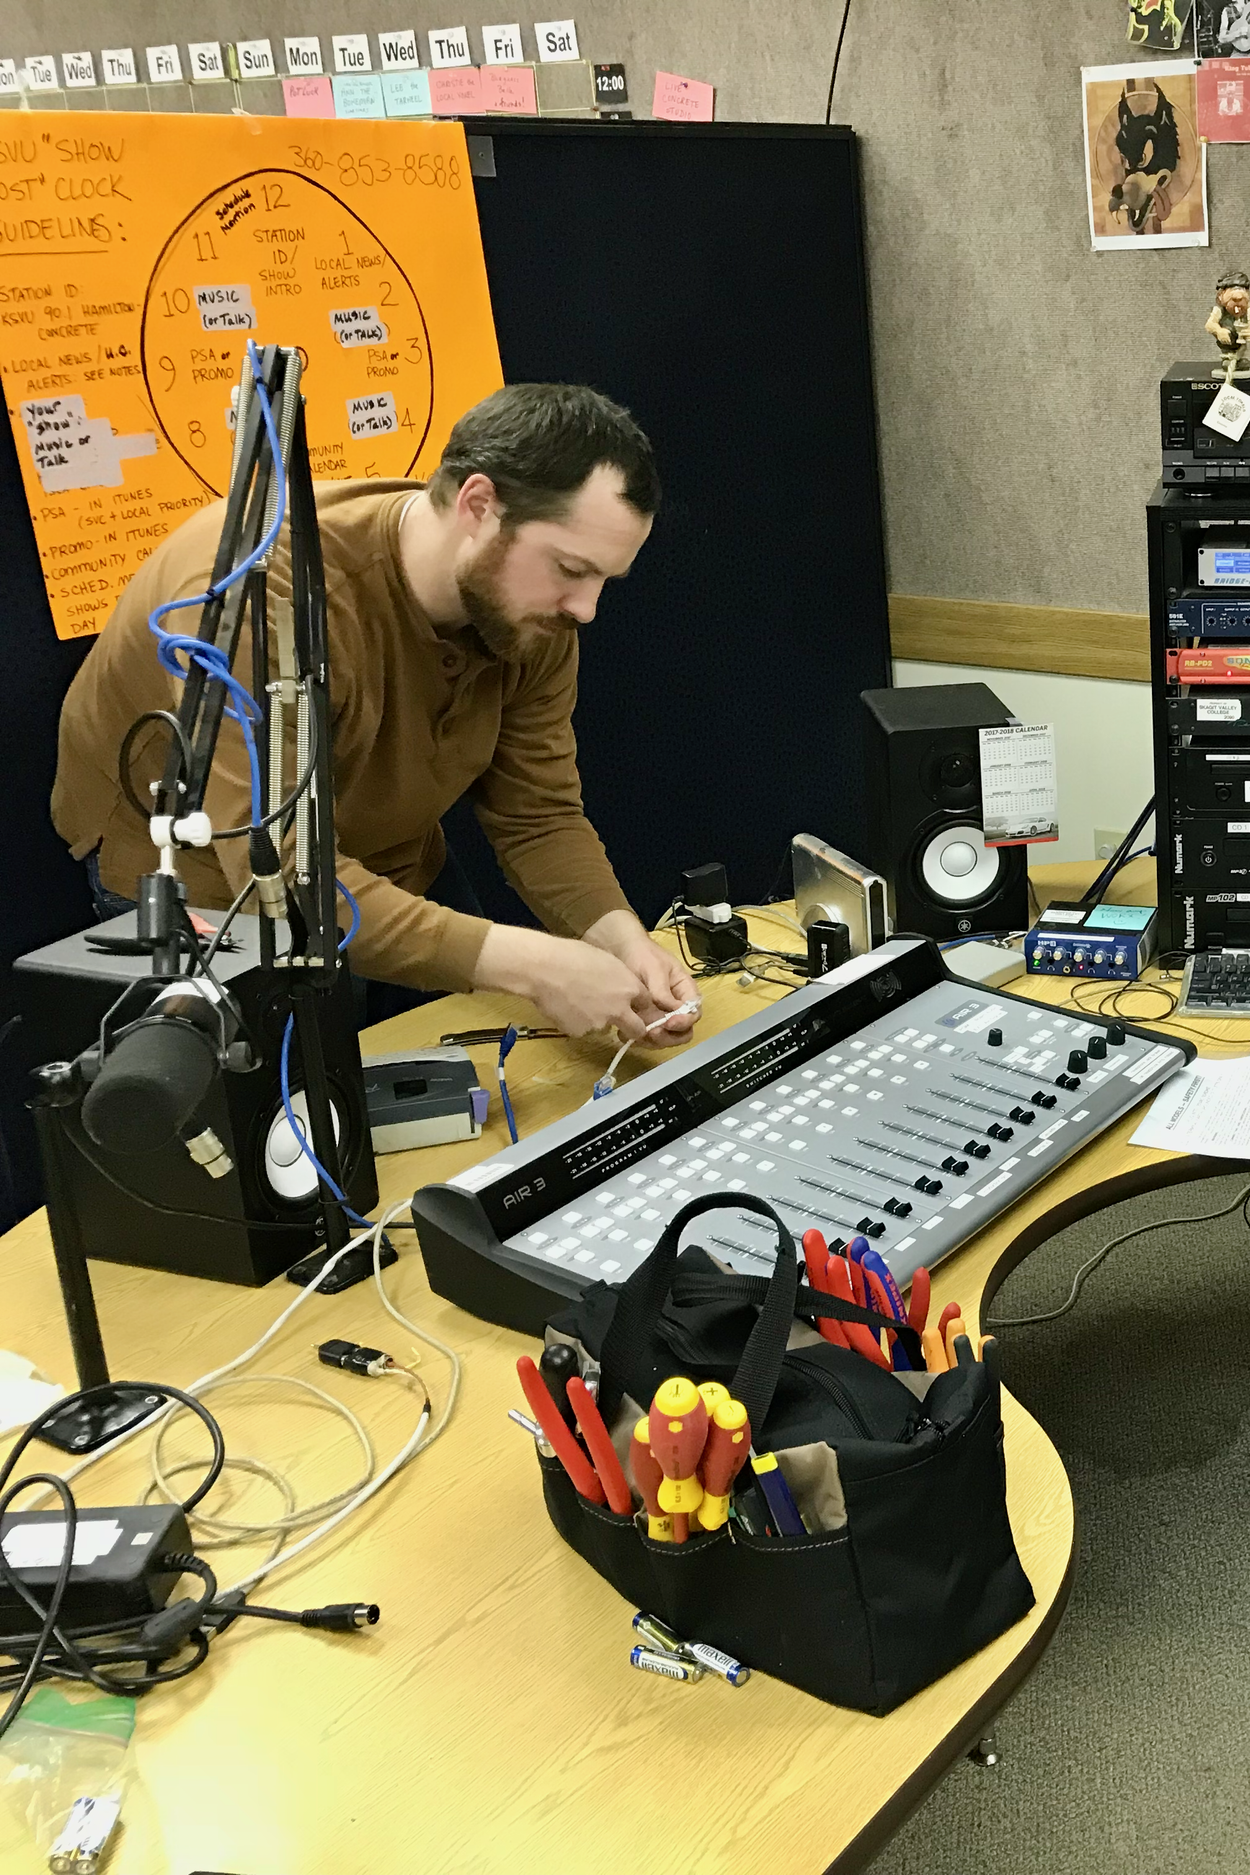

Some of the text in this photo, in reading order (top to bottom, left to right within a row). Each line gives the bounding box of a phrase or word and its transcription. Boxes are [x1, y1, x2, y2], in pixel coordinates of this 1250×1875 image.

[30, 32, 572, 83] Tue Wed Thu Fri Sat Sun Mon Tue Wed Thu Fri Sat
[597, 75, 624, 91] 12:00
[665, 83, 682, 92] LIVE
[662, 94, 699, 109] CONCRETE
[666, 108, 692, 119] STUDIO
[0, 173, 132, 201] OST" CLOCK
[261, 184, 291, 212] 12
[253, 227, 306, 243] STATION
[339, 230, 354, 256] 1
[193, 231, 219, 262] 11
[314, 256, 352, 272] LOCAL
[258, 267, 296, 282] SHOW
[321, 275, 360, 290] ALERTS
[0, 284, 52, 303] STATION
[197, 290, 240, 306] MUSIC
[265, 283, 302, 297] INTRO
[379, 281, 399, 307] 2
[161, 288, 190, 317] 10
[0, 310, 35, 327] KSVU
[38, 323, 100, 341] CONCRETE
[191, 349, 216, 364] PSA
[368, 349, 388, 364] PSA
[406, 338, 423, 364] 3
[11, 357, 51, 374] LOCAL
[58, 352, 92, 367] NEWS
[367, 366, 399, 378] PROMO
[83, 368, 105, 382] SEE
[110, 364, 141, 377] NOTES
[159, 355, 176, 392] 9
[192, 367, 234, 384] PROMO
[26, 401, 61, 421] Your
[401, 408, 416, 433] 4
[188, 420, 206, 448] 8
[34, 435, 91, 455] Music or
[36, 454, 69, 470] Talk
[40, 488, 153, 522] PSA IN ITUNES
[120, 506, 151, 520] LOCAL
[104, 523, 169, 544] IN ITUNES
[51, 554, 126, 581] COMMUNITY
[61, 579, 114, 598] SCHED.
[66, 599, 109, 618] SHOWS
[71, 617, 96, 634] DAY
[1015, 725, 1048, 733] CALENDAR
[1174, 834, 1183, 874] Numark
[1183, 896, 1195, 949] Numark
[952, 1003, 980, 1020] AIR 3
[1170, 1106, 1184, 1122] MODELS
[1166, 1122, 1175, 1130] ALL
[601, 1152, 633, 1174] PROGRAM
[503, 1177, 546, 1210] AIR 3
[698, 1644, 732, 1667] maxell
[641, 1661, 679, 1679] maxell
